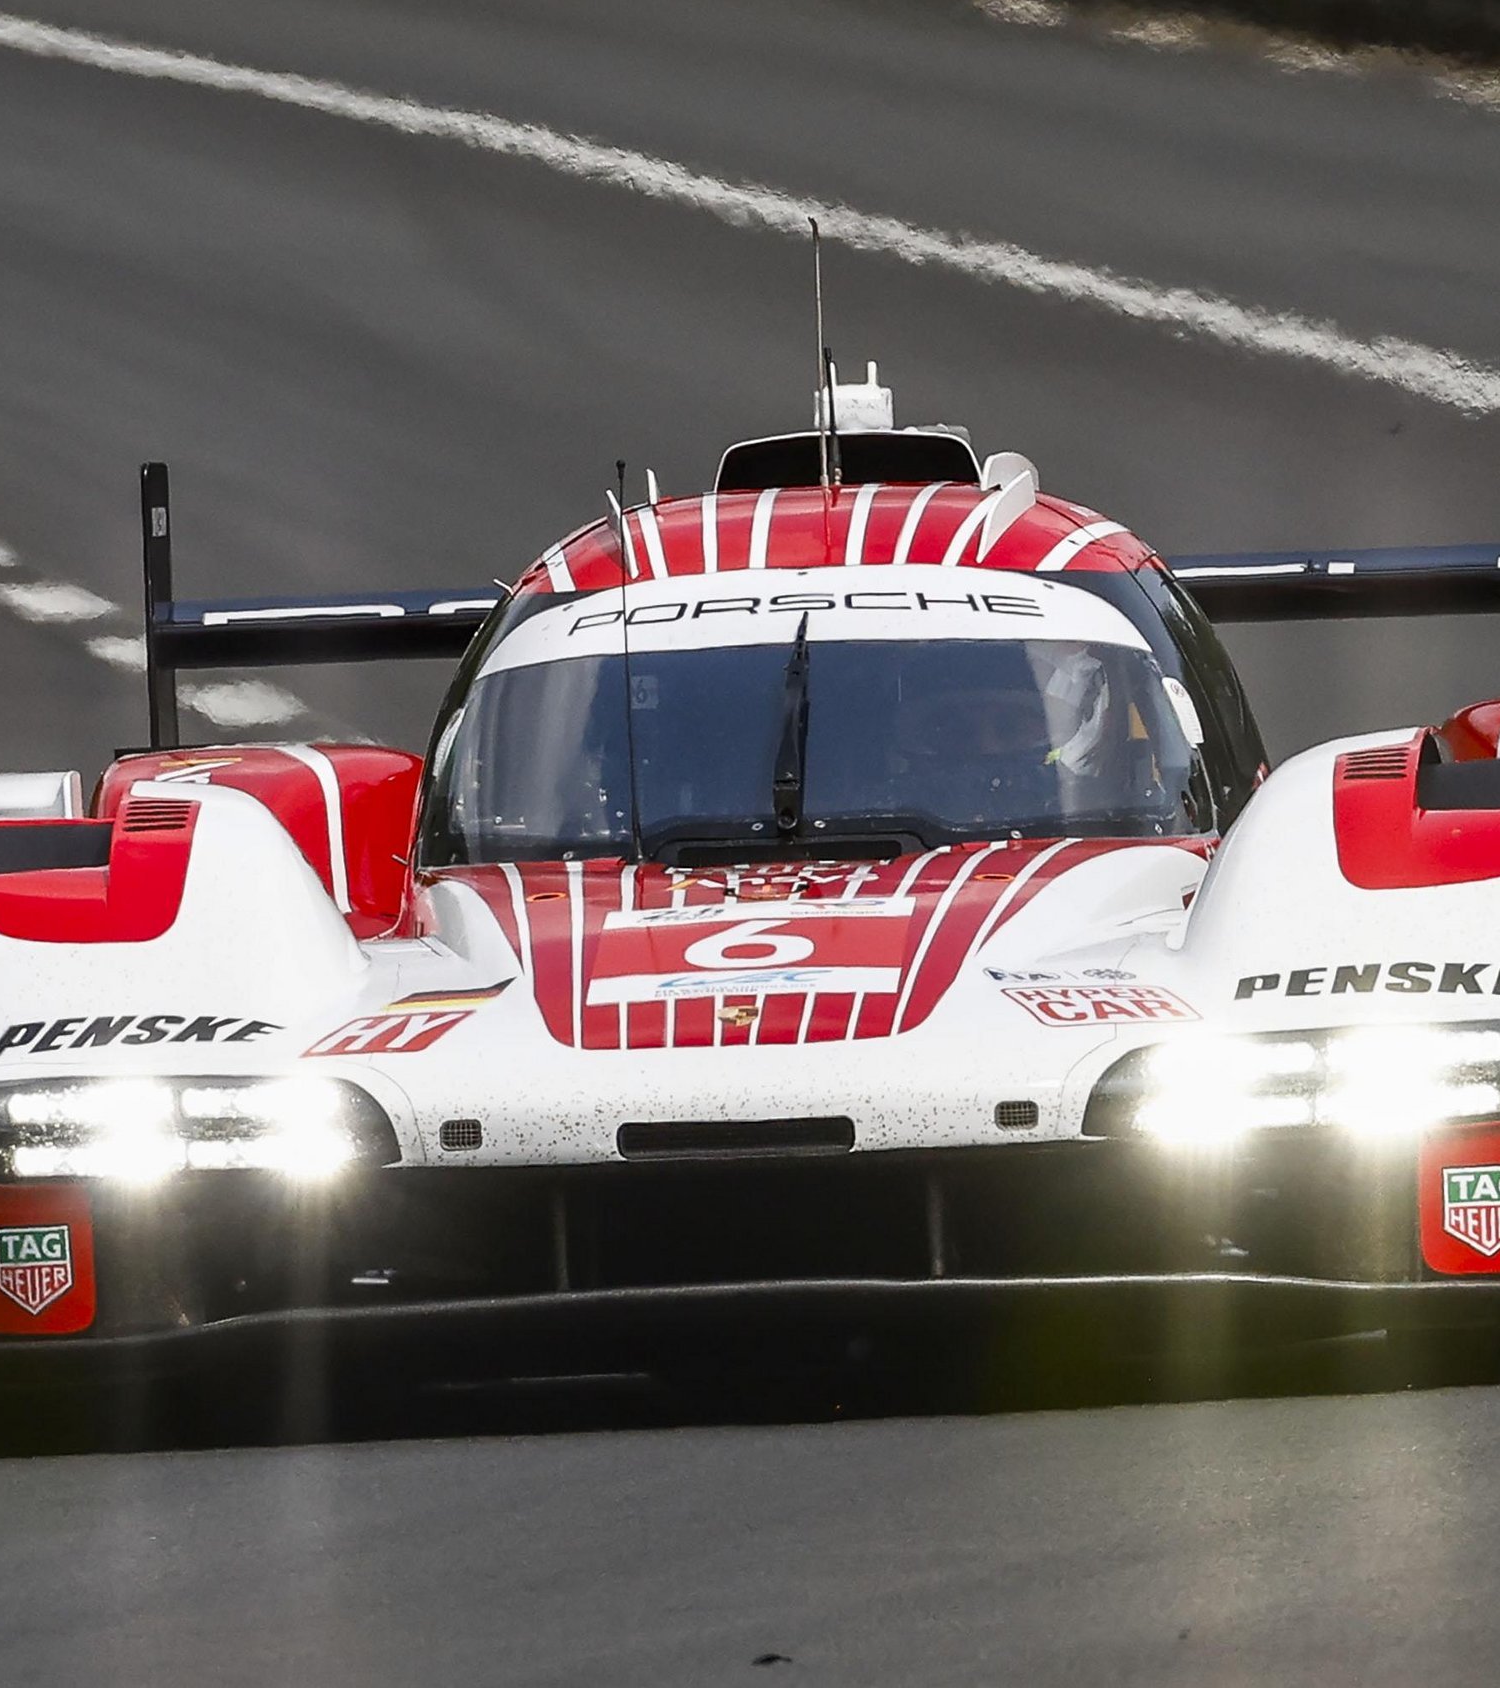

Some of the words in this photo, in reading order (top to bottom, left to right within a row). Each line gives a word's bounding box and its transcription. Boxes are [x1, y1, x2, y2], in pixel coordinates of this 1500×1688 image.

[568, 592, 1043, 635] PORSCHE
[684, 920, 814, 969] 6
[1016, 988, 1162, 1001] HYPER
[1037, 999, 1187, 1021] CAR
[315, 1011, 472, 1055] HY
[1, 1232, 61, 1260] TAG
[1, 1267, 66, 1306] HEUER
